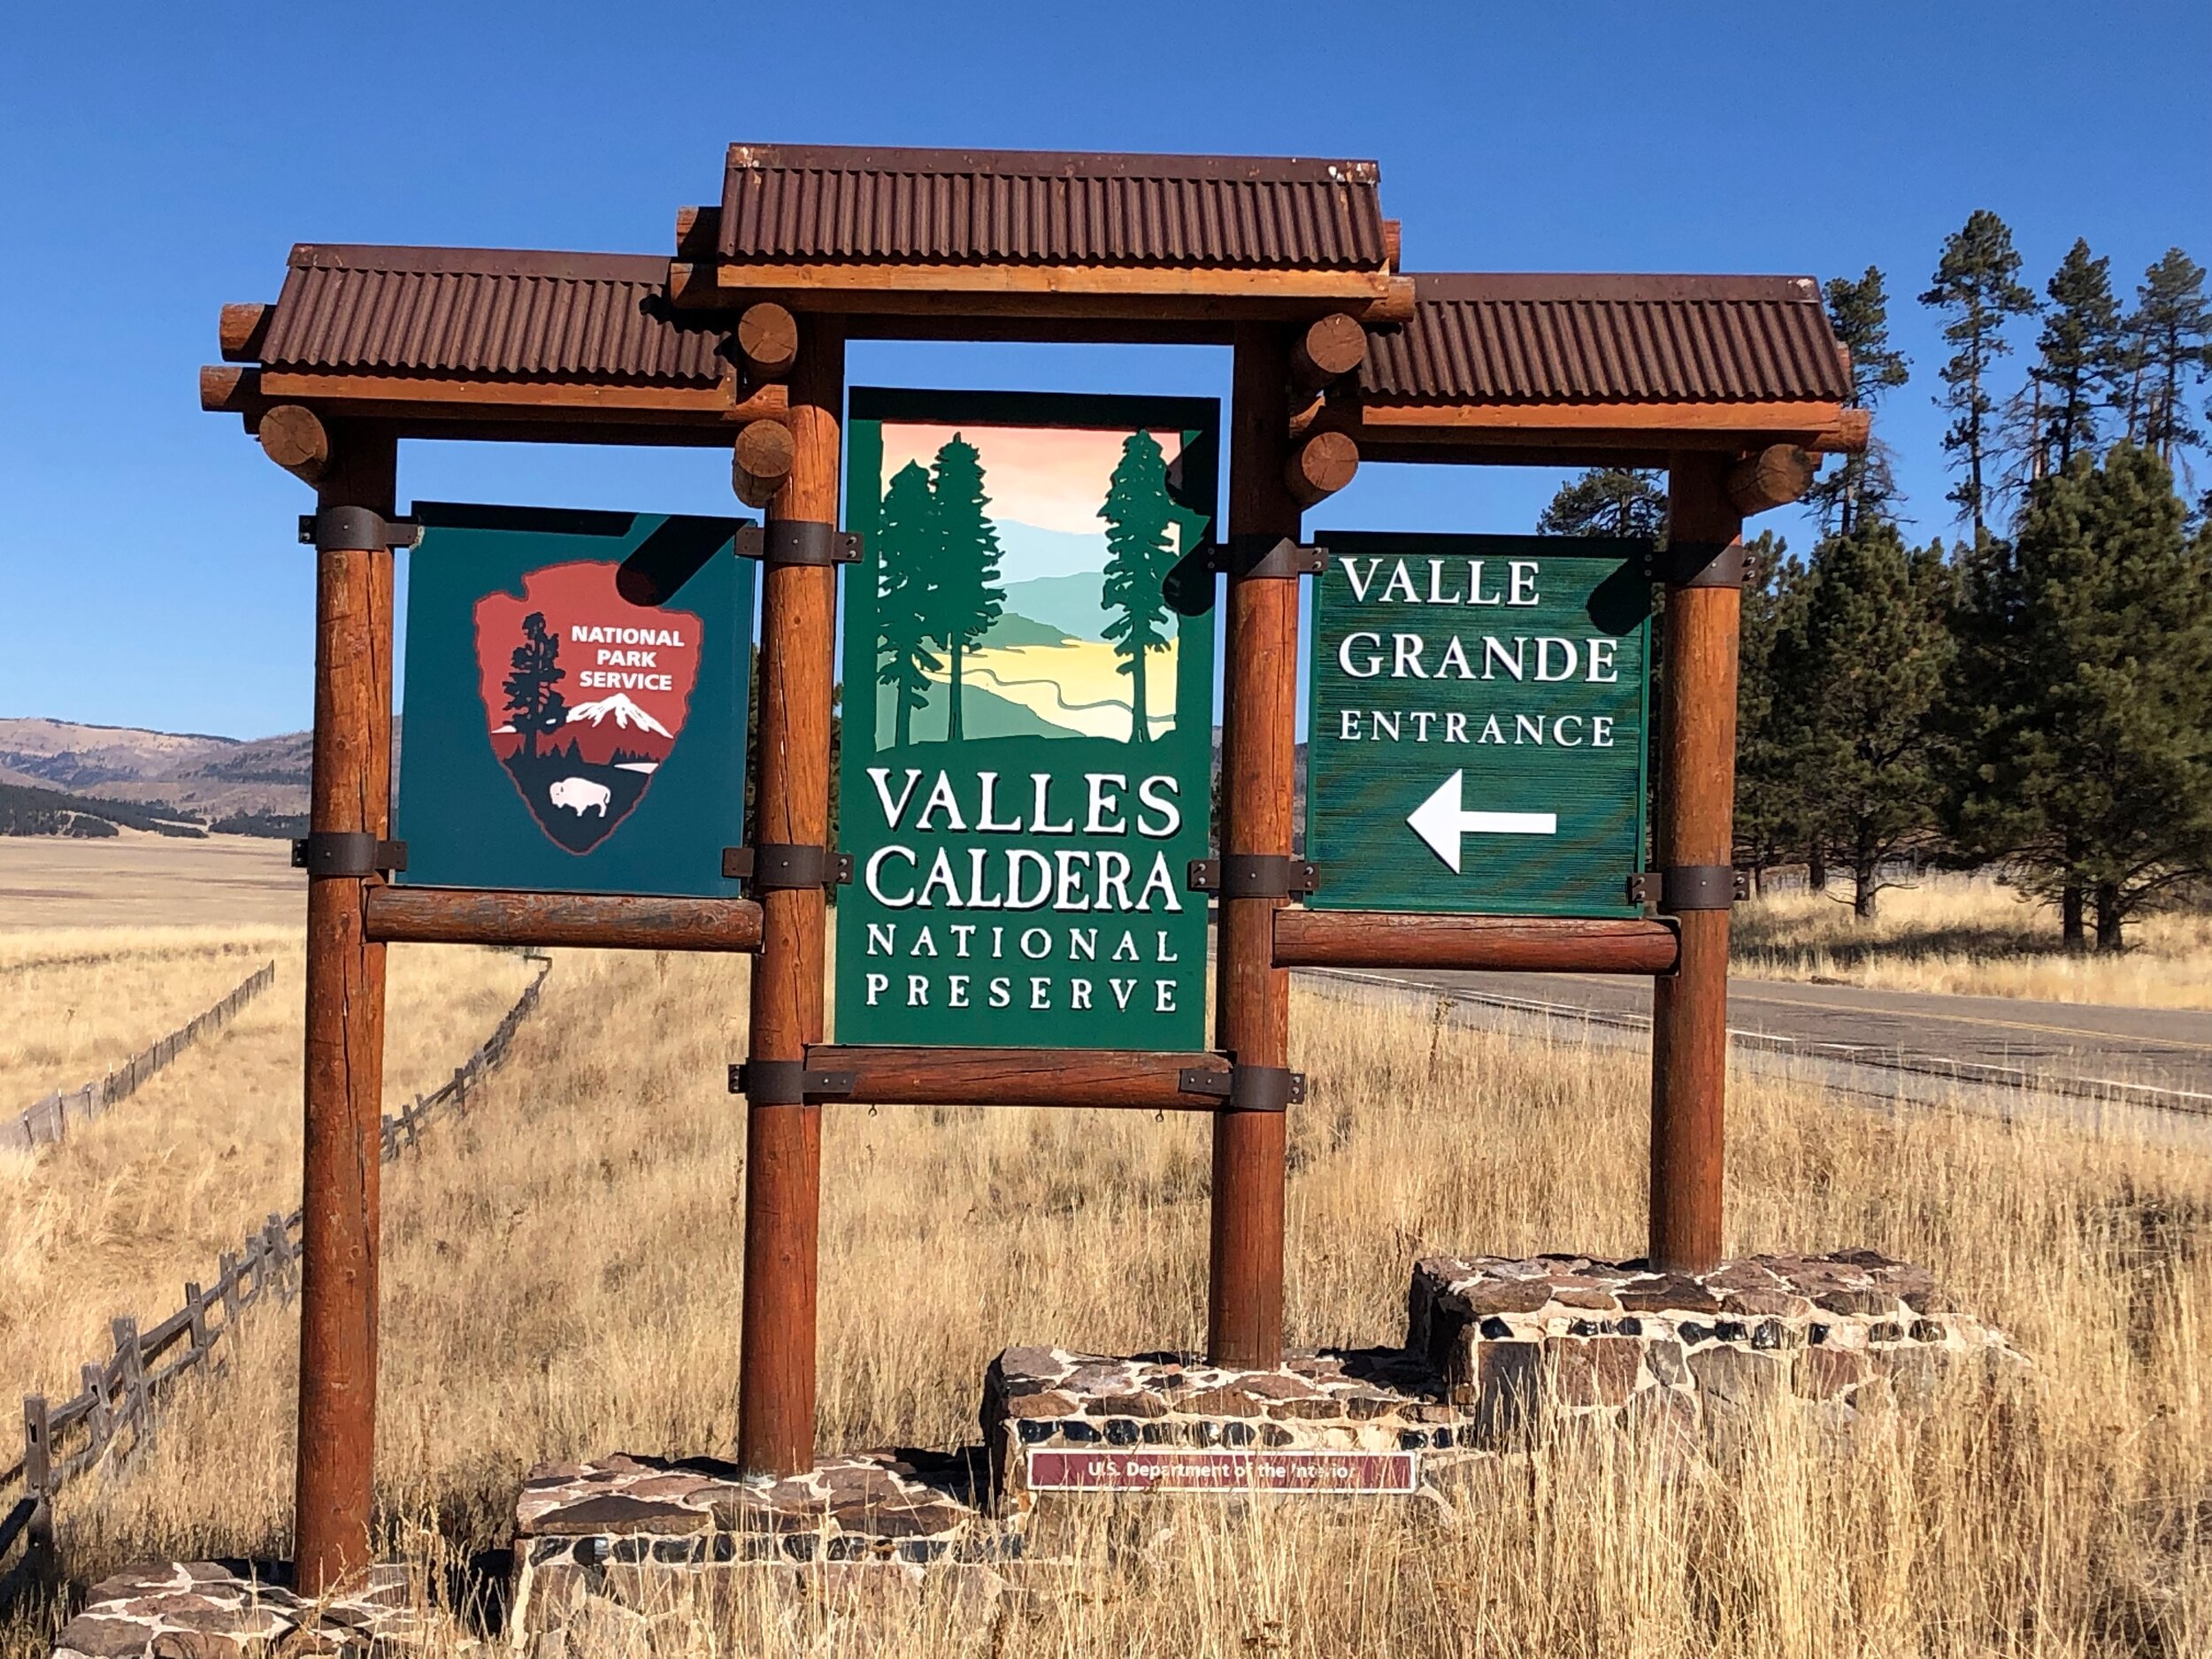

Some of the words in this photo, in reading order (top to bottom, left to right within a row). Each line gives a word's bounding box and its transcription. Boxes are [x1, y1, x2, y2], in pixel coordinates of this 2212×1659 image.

[1338, 557, 1540, 606] VALLE
[572, 625, 686, 647] NATIONAL
[596, 649, 657, 669] PARK
[1337, 631, 1619, 683] GRANDE
[580, 670, 672, 691] SERVICE
[1339, 709, 1615, 748] ENTRANCE
[865, 767, 1182, 838] VALLES
[864, 845, 1184, 912] CALDERA
[865, 923, 1179, 963] NATIONAL
[864, 972, 1178, 1012] PRESERVE
[1088, 1461, 1121, 1477] U.S.
[1126, 1461, 1230, 1481] Department
[1257, 1462, 1286, 1479] the
[1291, 1462, 1356, 1479] Inteior
